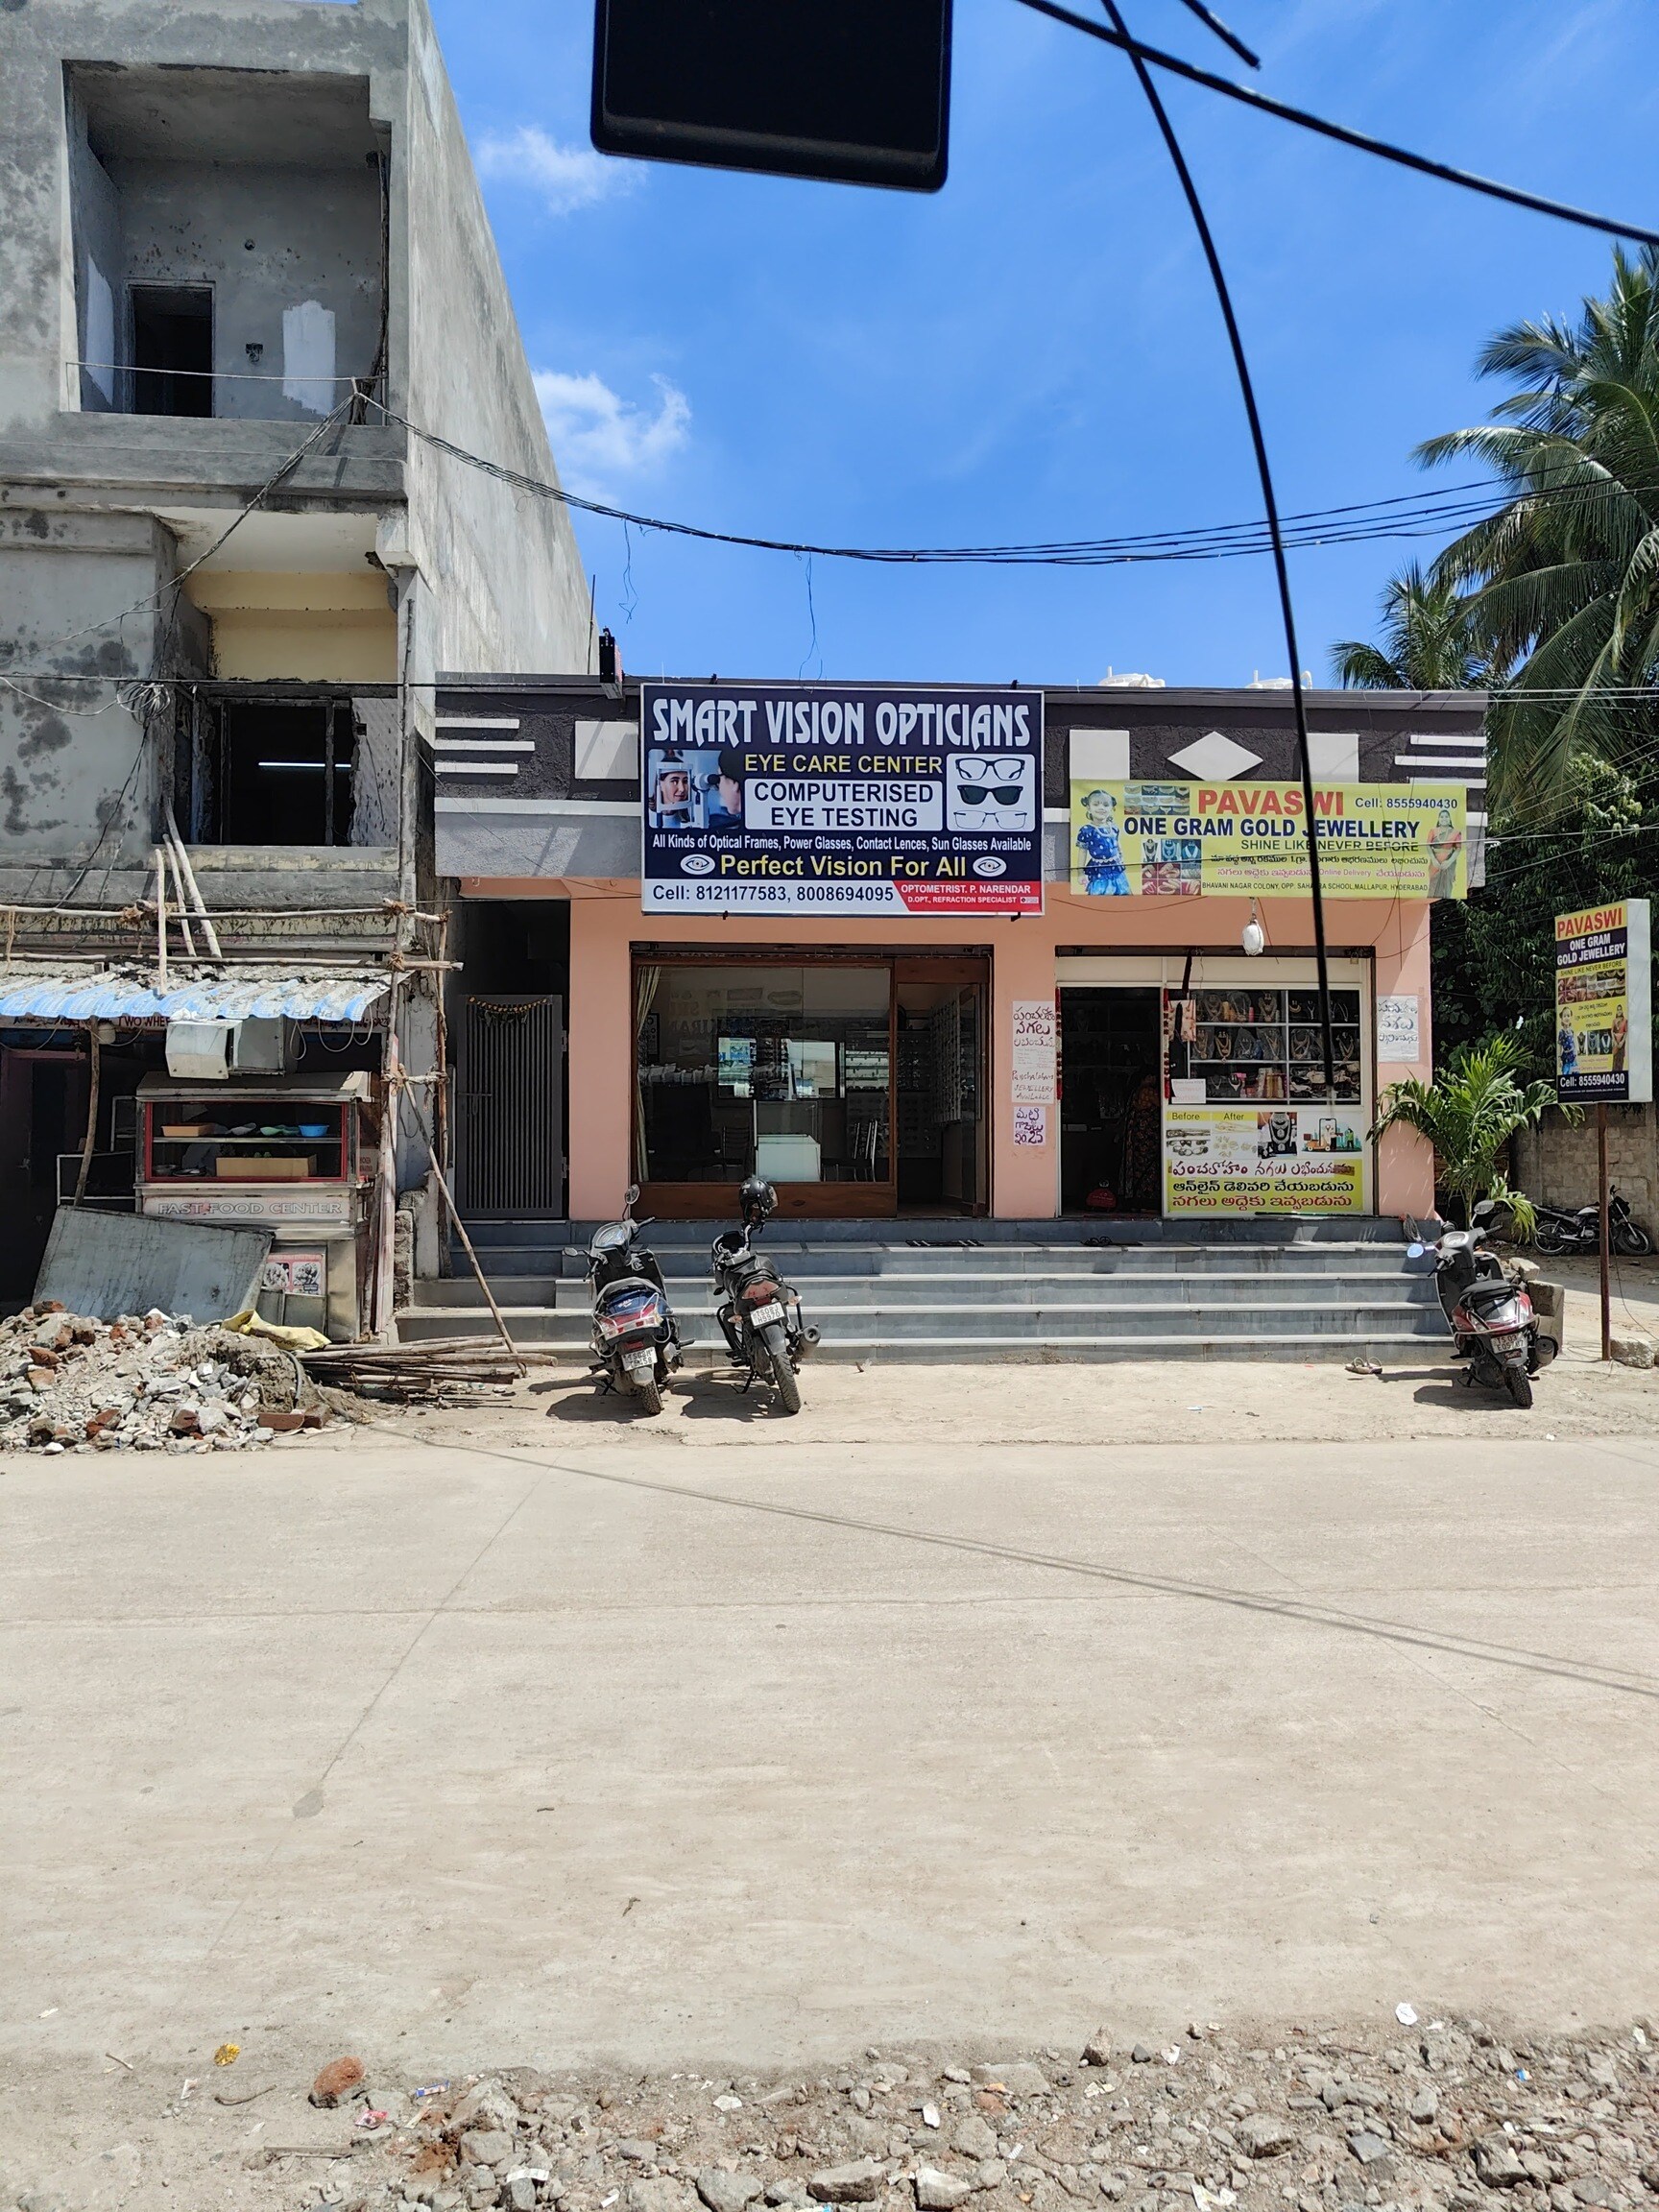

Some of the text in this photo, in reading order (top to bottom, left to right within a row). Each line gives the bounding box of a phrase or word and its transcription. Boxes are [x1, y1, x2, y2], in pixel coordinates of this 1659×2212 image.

[653, 698, 1031, 752] SMART VISION OPTICIANS
[745, 754, 943, 774] EYE CARE CENTER
[755, 781, 933, 803] COMPUTERISED
[1198, 789, 1457, 816] PAVASWI Cell: 8555940430
[771, 807, 918, 828] EYE TESTING
[1124, 817, 1167, 835] ONE
[1173, 818, 1234, 836] GRAM
[1240, 819, 1296, 837] GOLD
[653, 834, 1031, 853] All Kinds of Optical Frames, Power Glasses, Contact Lences, Sun Glasses Available
[1241, 840, 1419, 852] SHINE LIKE NEVER BEFORE
[721, 854, 966, 877] Perfect Vision For All
[653, 885, 894, 903] Cell: 8121177583, 8008694095
[901, 885, 1031, 894] OPTOMETRIST. P. NARENDAR
[1557, 907, 1623, 939] PAVASWI
[1569, 933, 1611, 951] ONE GRAM
[1557, 942, 1625, 966] GOLD JEWELLERY
[118, 1016, 141, 1027] TWO
[1016, 1021, 1050, 1035] నగలు
[1560, 1072, 1625, 1088] Cell: 8555940430
[1172, 1112, 1244, 1120] Before After
[1274, 1179, 1355, 1191] చేయబడును
[157, 1202, 342, 1214] FAST FOOD CENTER
[1172, 1195, 1217, 1207] నగలు
[1221, 1195, 1266, 1211] అద్దెకు
